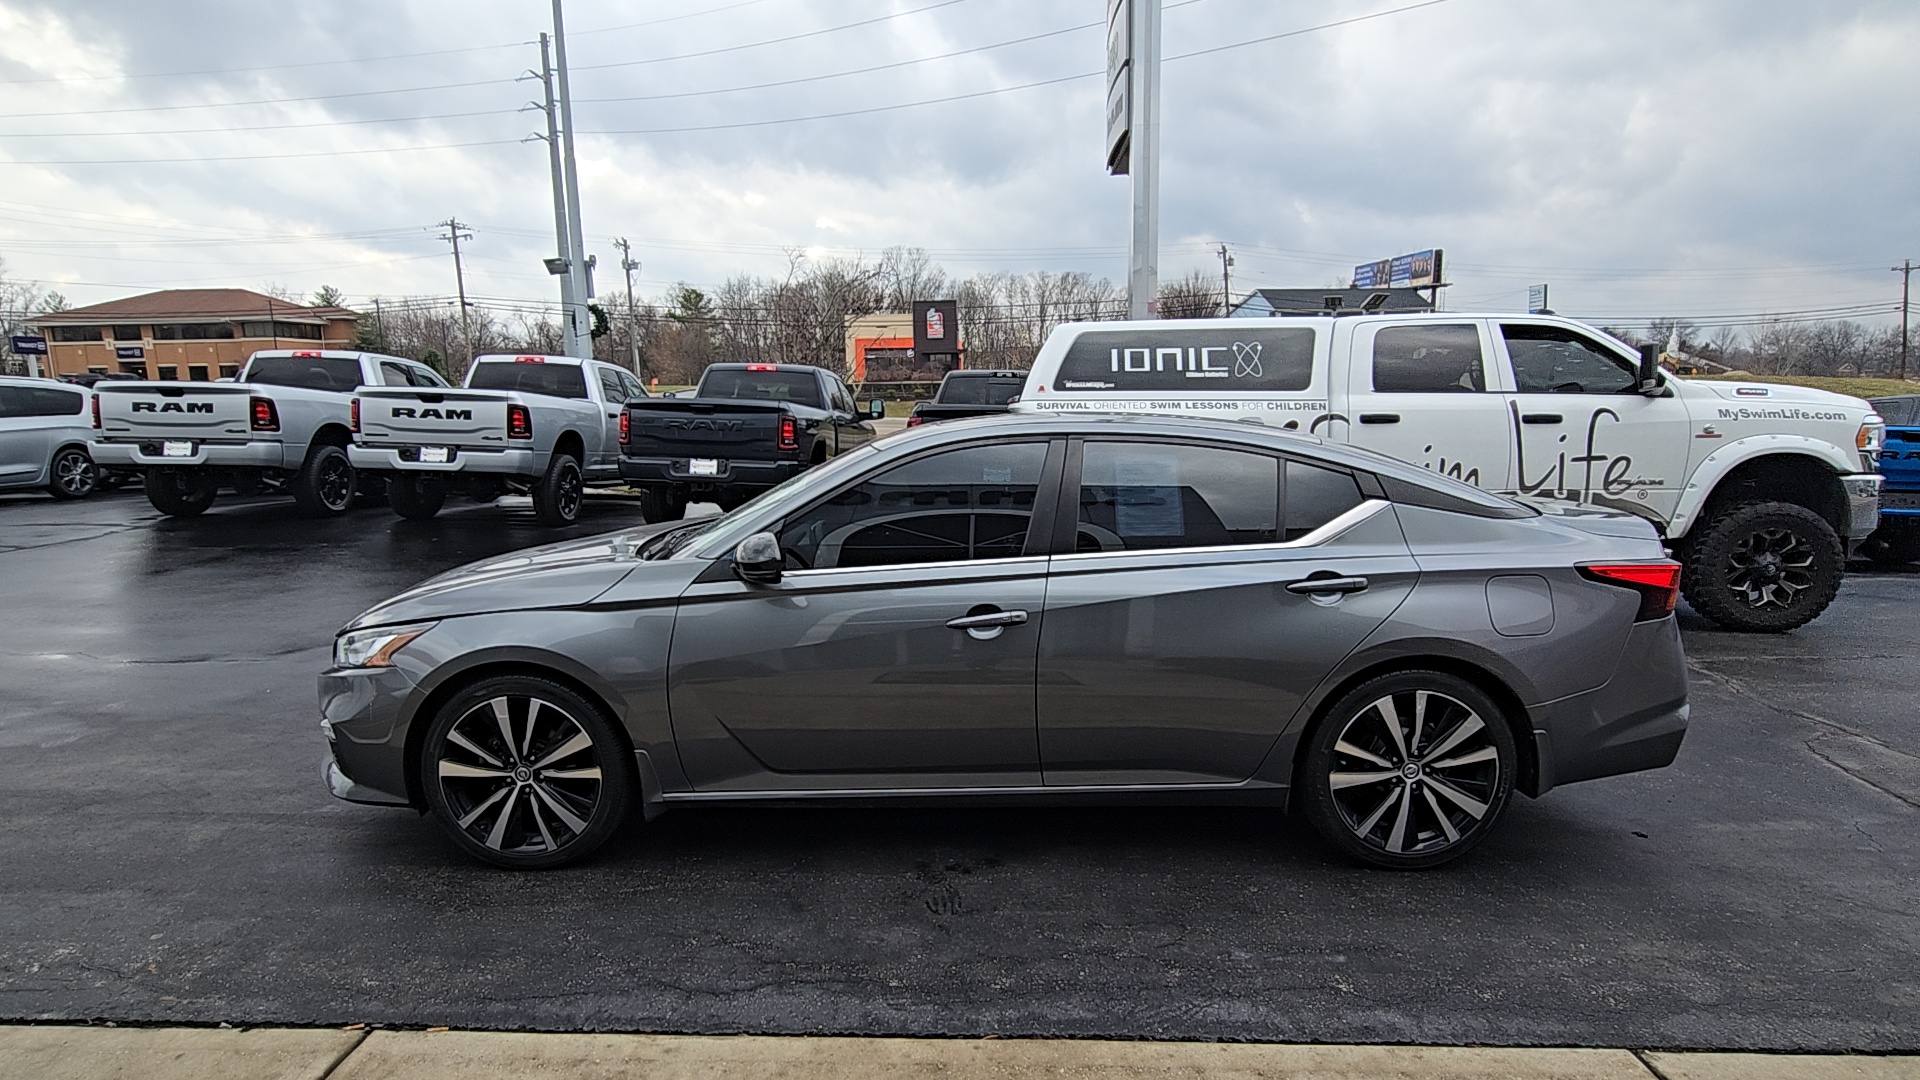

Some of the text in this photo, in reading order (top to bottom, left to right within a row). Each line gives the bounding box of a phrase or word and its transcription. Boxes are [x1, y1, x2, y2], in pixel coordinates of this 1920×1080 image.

[1110, 347, 1229, 372] IONIC
[131, 402, 214, 414] RAM
[1036, 402, 1327, 411] SURVIVAL ORIENTED SWIM LESSONS FOR CHILDREN
[392, 407, 472, 420] RAM
[1717, 408, 1847, 421] MySwimLife.com
[662, 418, 744, 432] RAM
[1509, 399, 1641, 503] Life
[1880, 451, 1920, 460] RA
